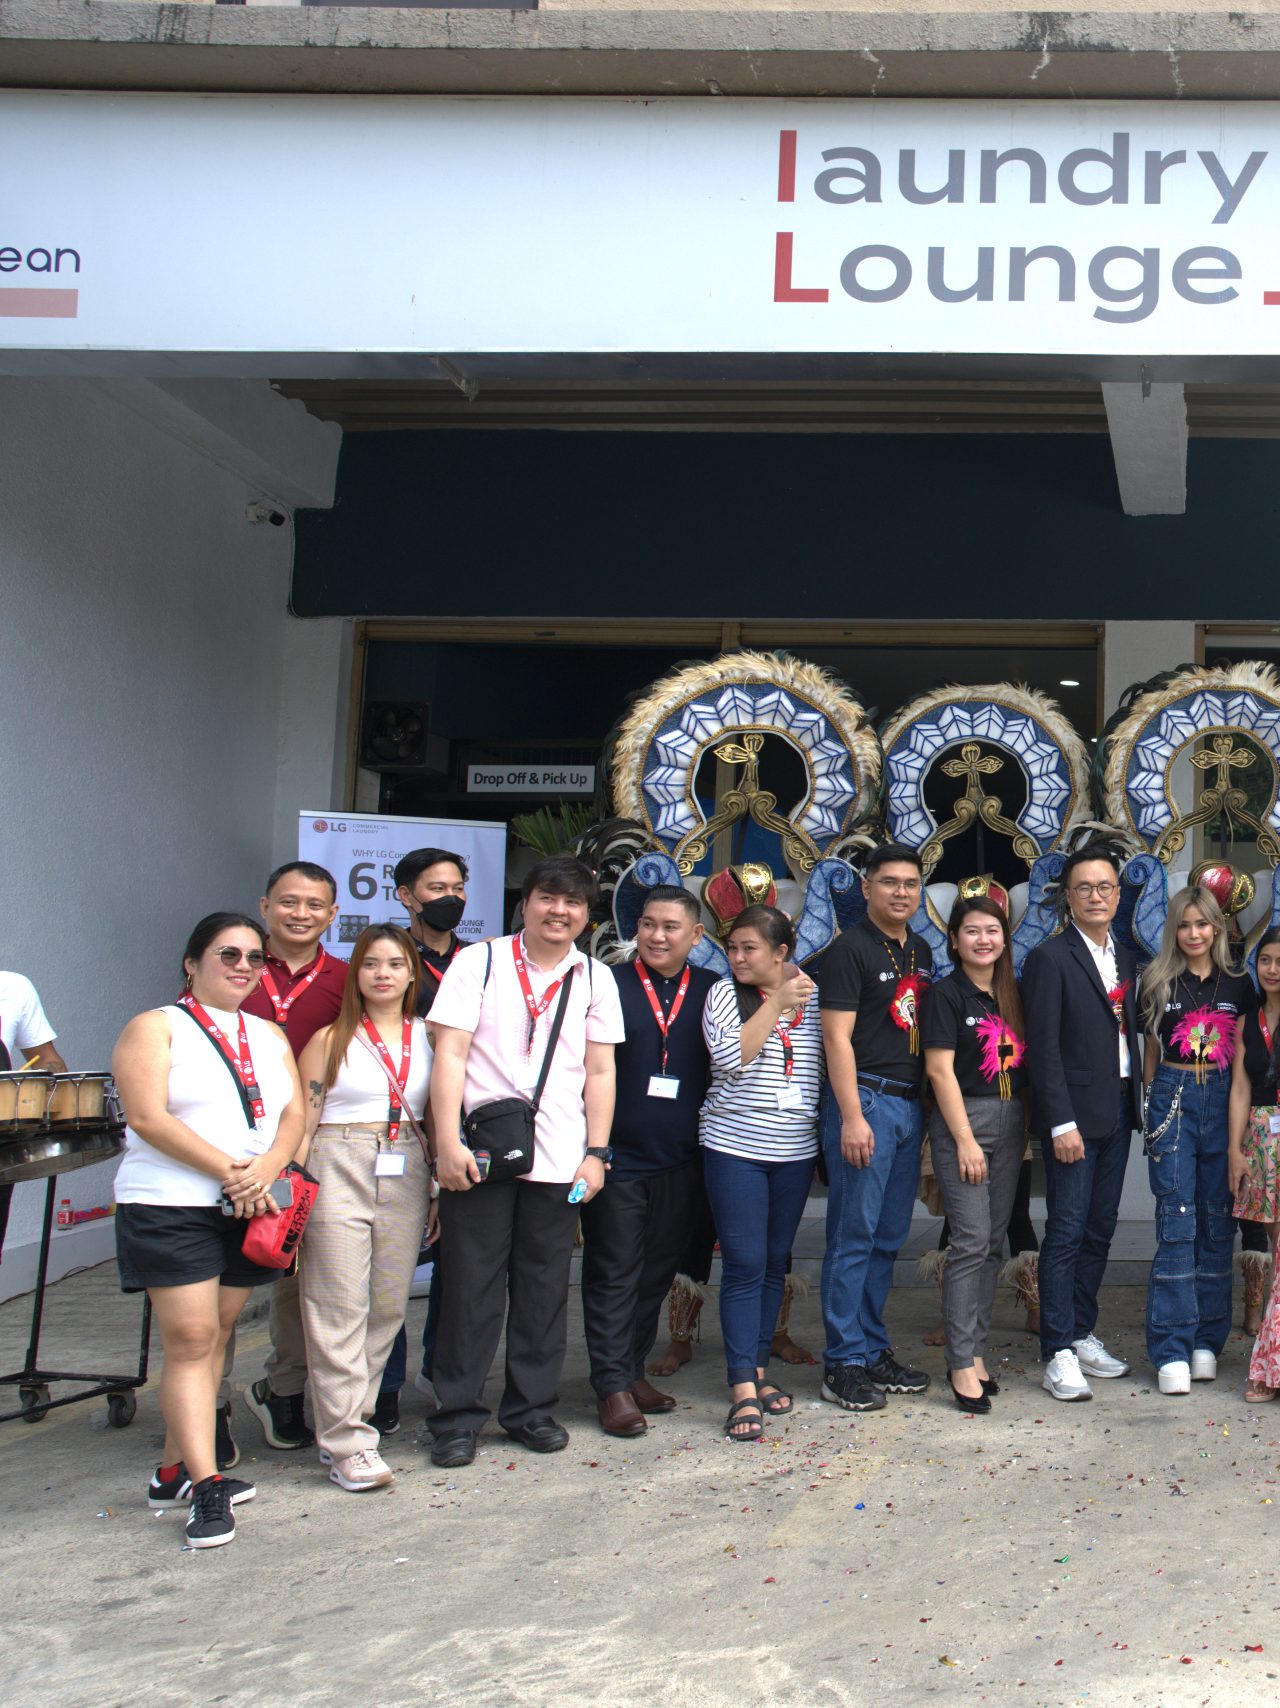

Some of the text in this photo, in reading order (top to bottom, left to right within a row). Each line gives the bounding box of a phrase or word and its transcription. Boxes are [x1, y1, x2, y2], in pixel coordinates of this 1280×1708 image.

[777, 129, 1269, 224] laundry
[773, 231, 1243, 324] Lounge
[474, 772, 587, 787] Drop Off & Pick Up
[330, 822, 347, 832] LG
[352, 849, 374, 857] WHY
[376, 850, 387, 858] LG
[348, 862, 378, 901] 6
